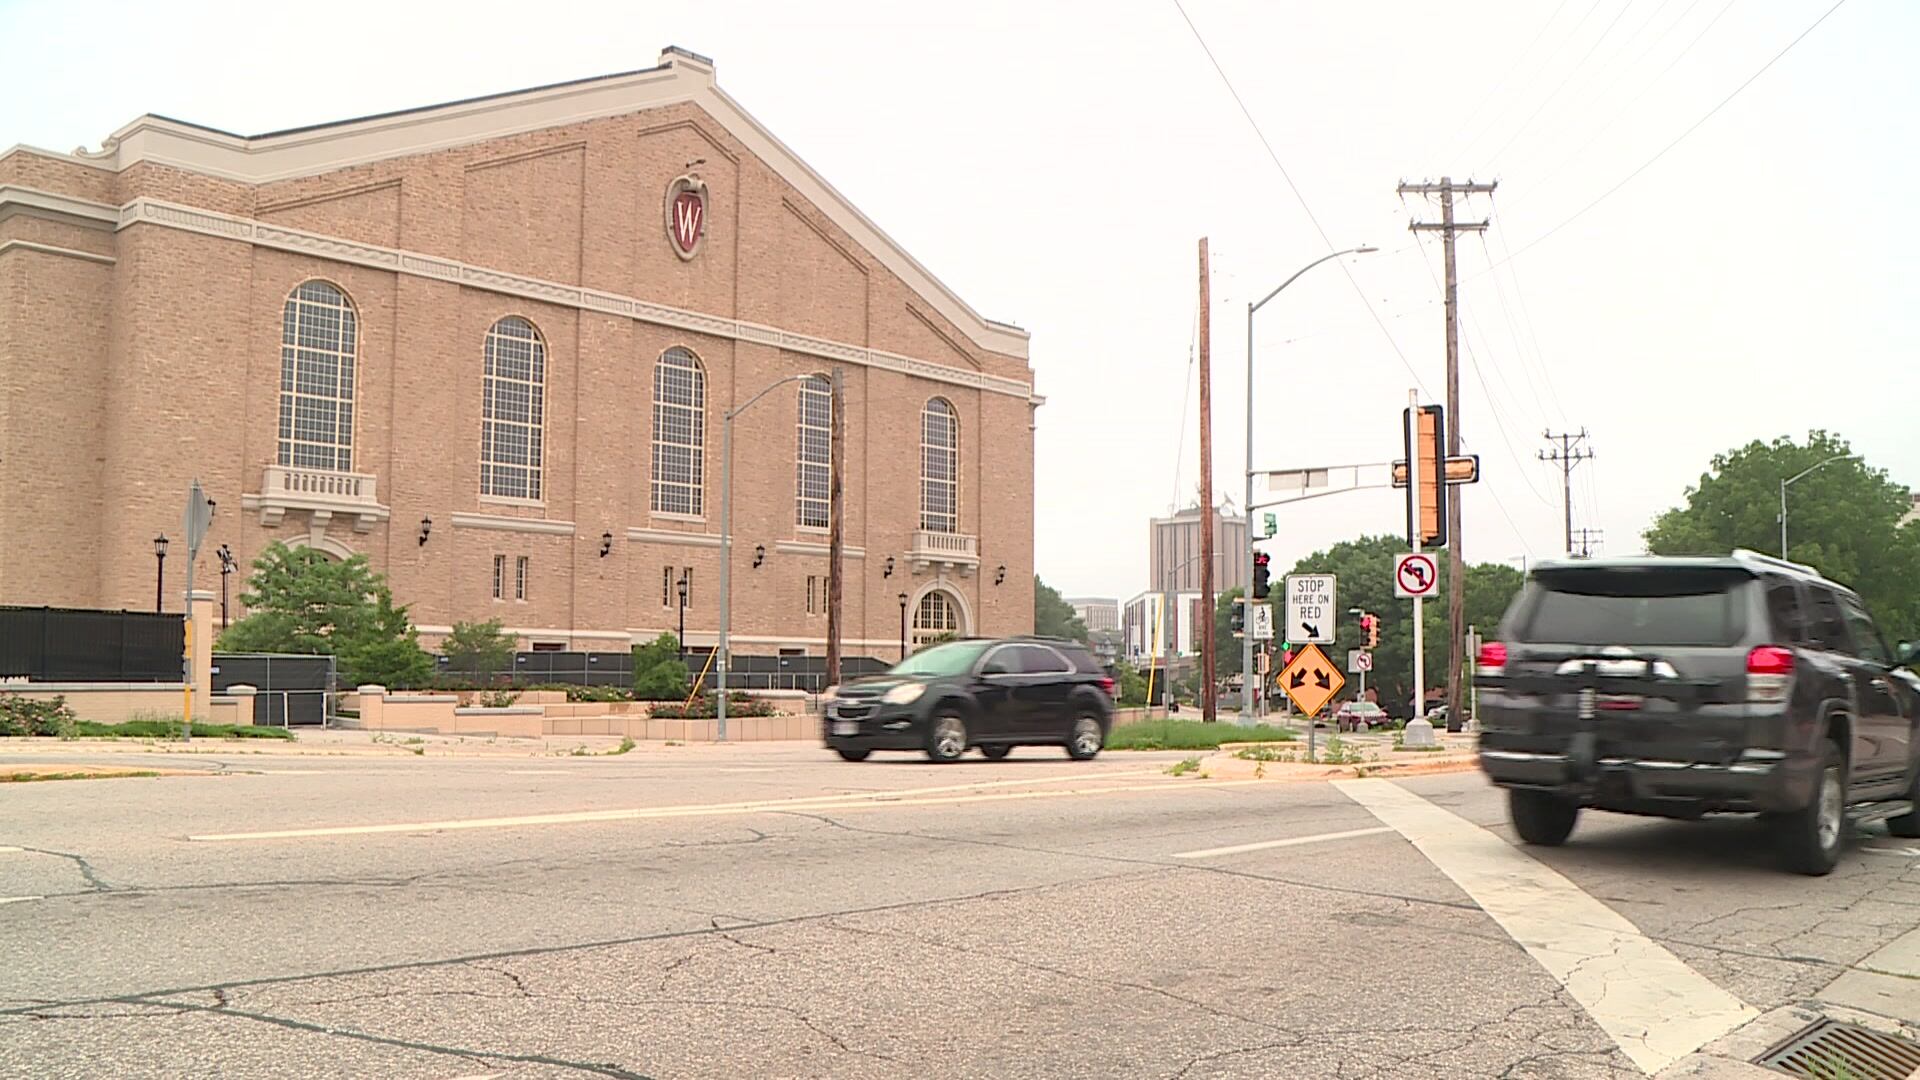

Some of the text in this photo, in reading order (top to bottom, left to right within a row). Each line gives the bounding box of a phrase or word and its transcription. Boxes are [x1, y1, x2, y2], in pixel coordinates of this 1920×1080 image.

[677, 201, 701, 243] W
[1298, 580, 1324, 592] STOP
[1293, 595, 1329, 604] HERE ON
[1300, 606, 1321, 619] RED
